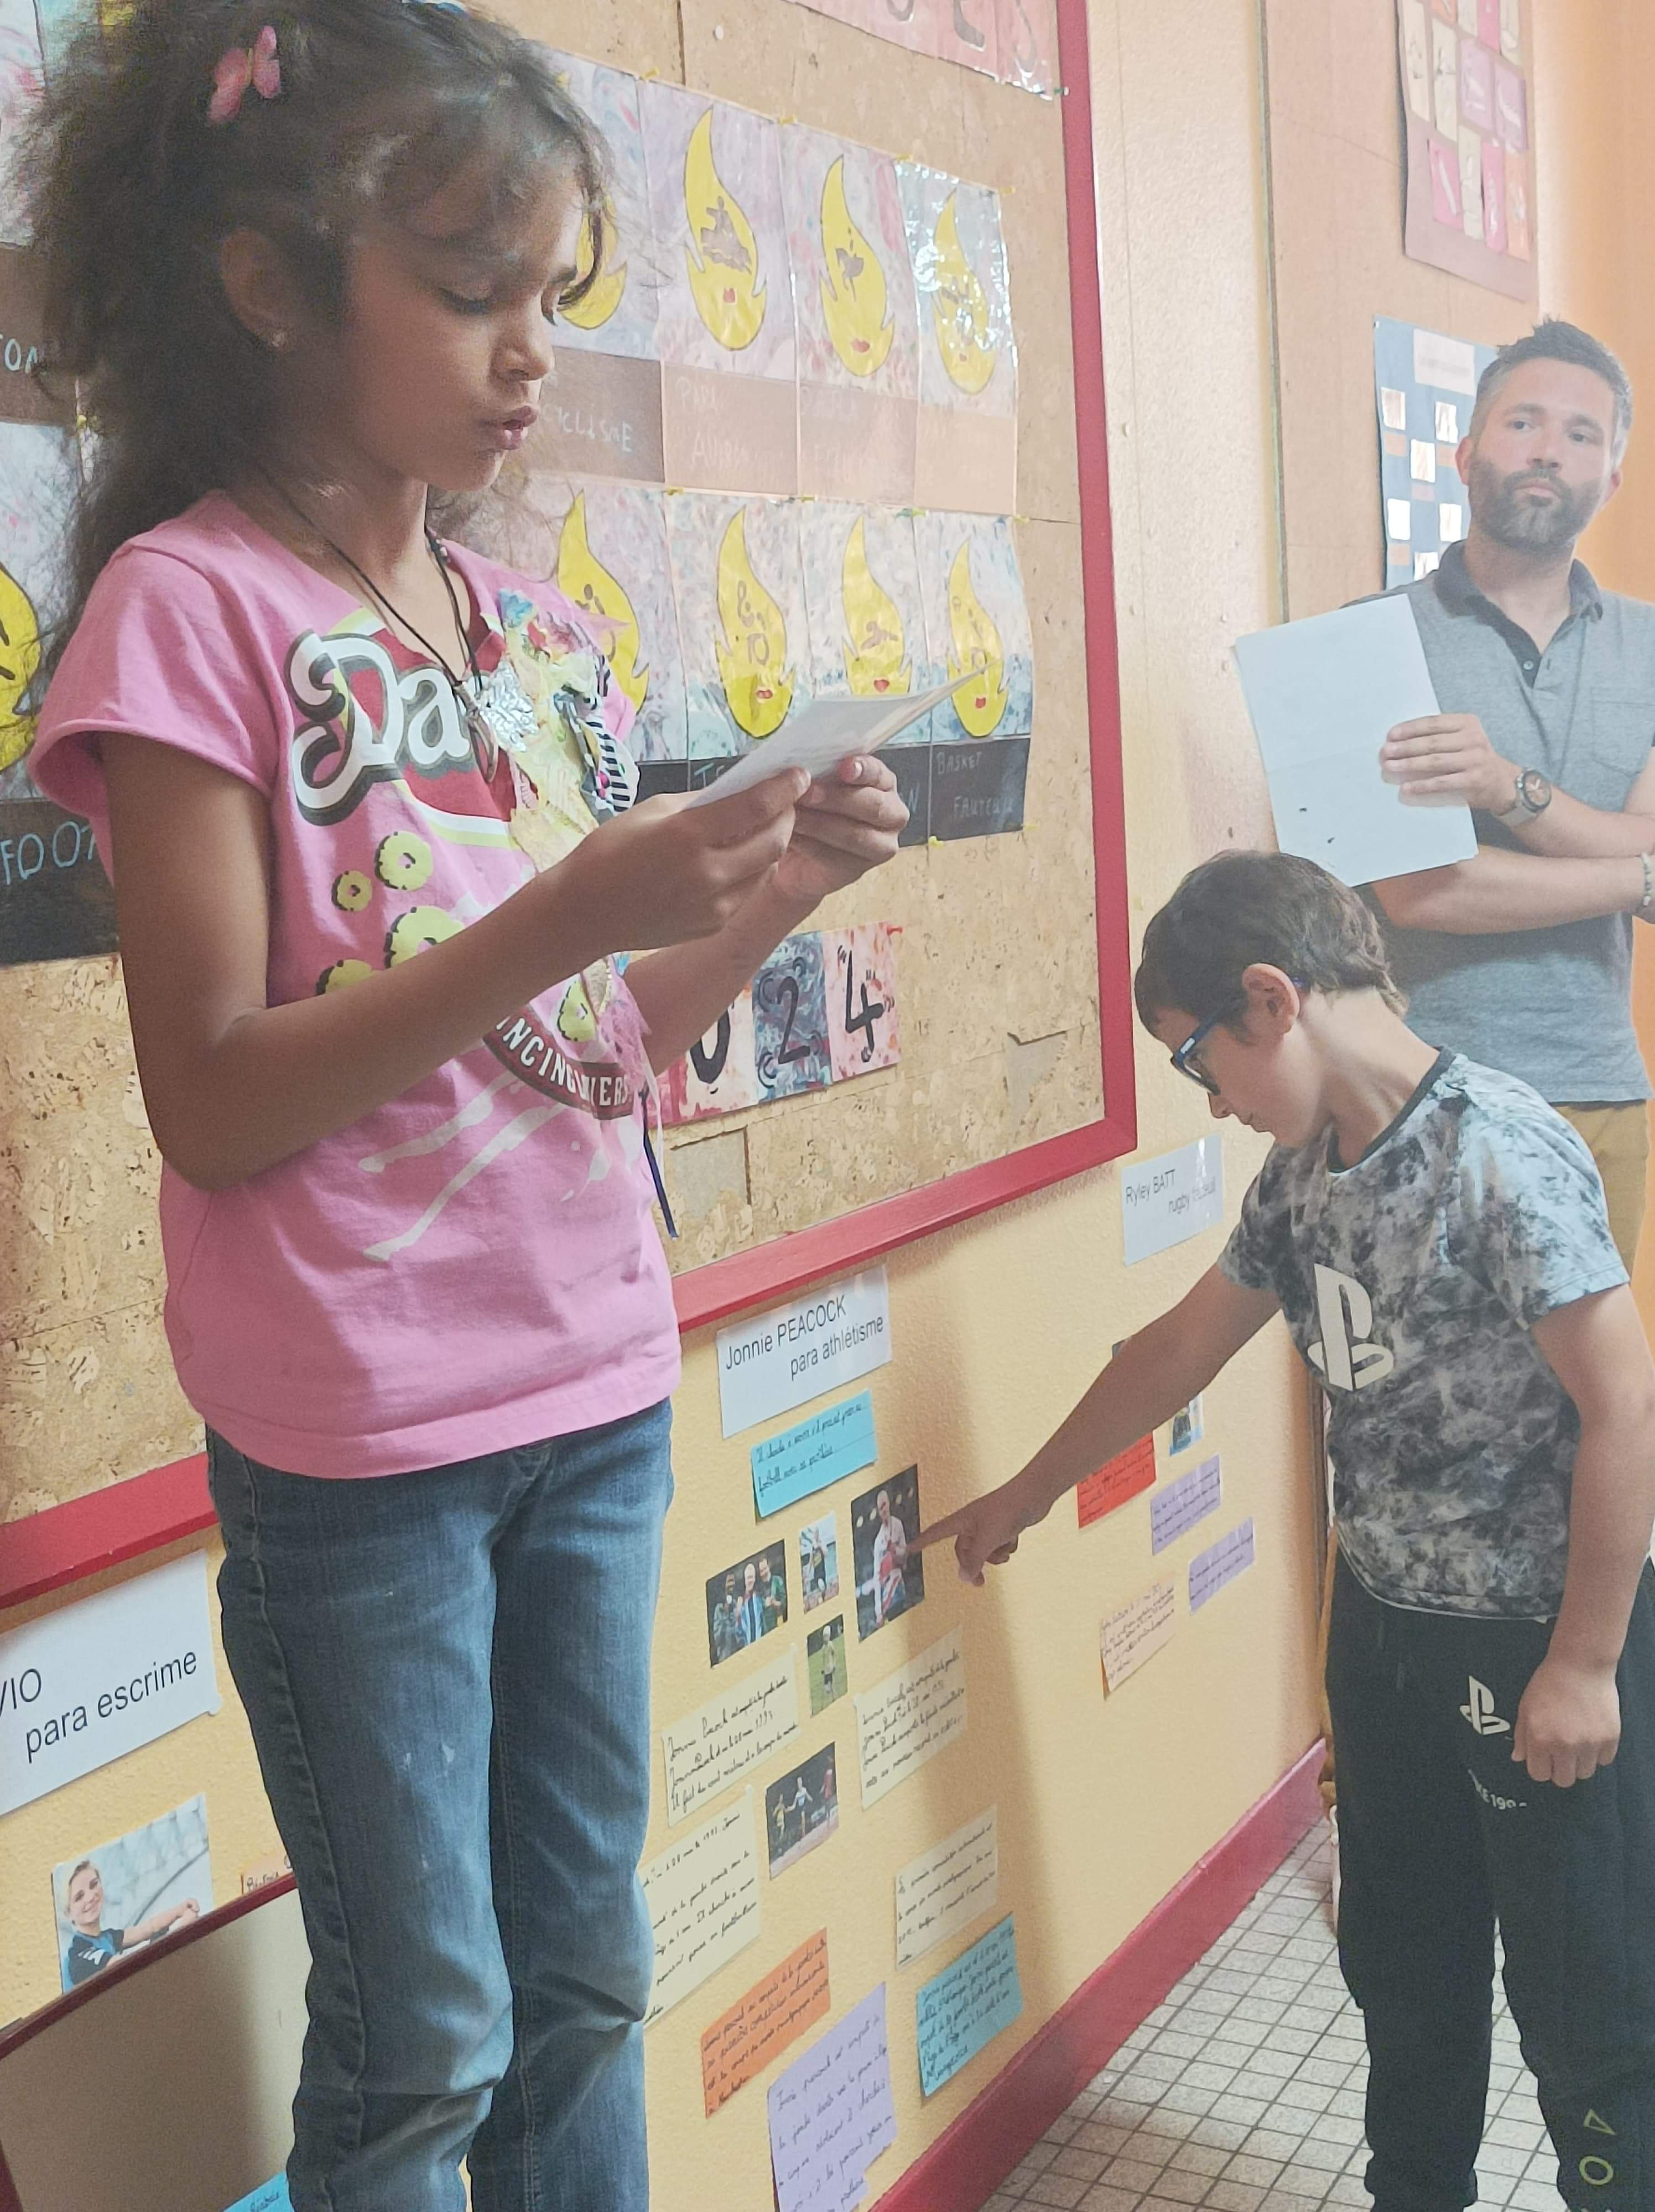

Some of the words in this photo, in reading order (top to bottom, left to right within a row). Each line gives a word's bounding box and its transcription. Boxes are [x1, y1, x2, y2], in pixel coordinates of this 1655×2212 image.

[496, 1015, 576, 1093] NCING
[1153, 1168, 1175, 1194] BATT
[726, 1333, 773, 1370] Jonnie
[777, 1295, 847, 1347] PEACOCK
[790, 1348, 818, 1382] para
[822, 1316, 884, 1360] athlétisme
[26, 1705, 89, 1764] para
[97, 1651, 197, 1718] escrime
